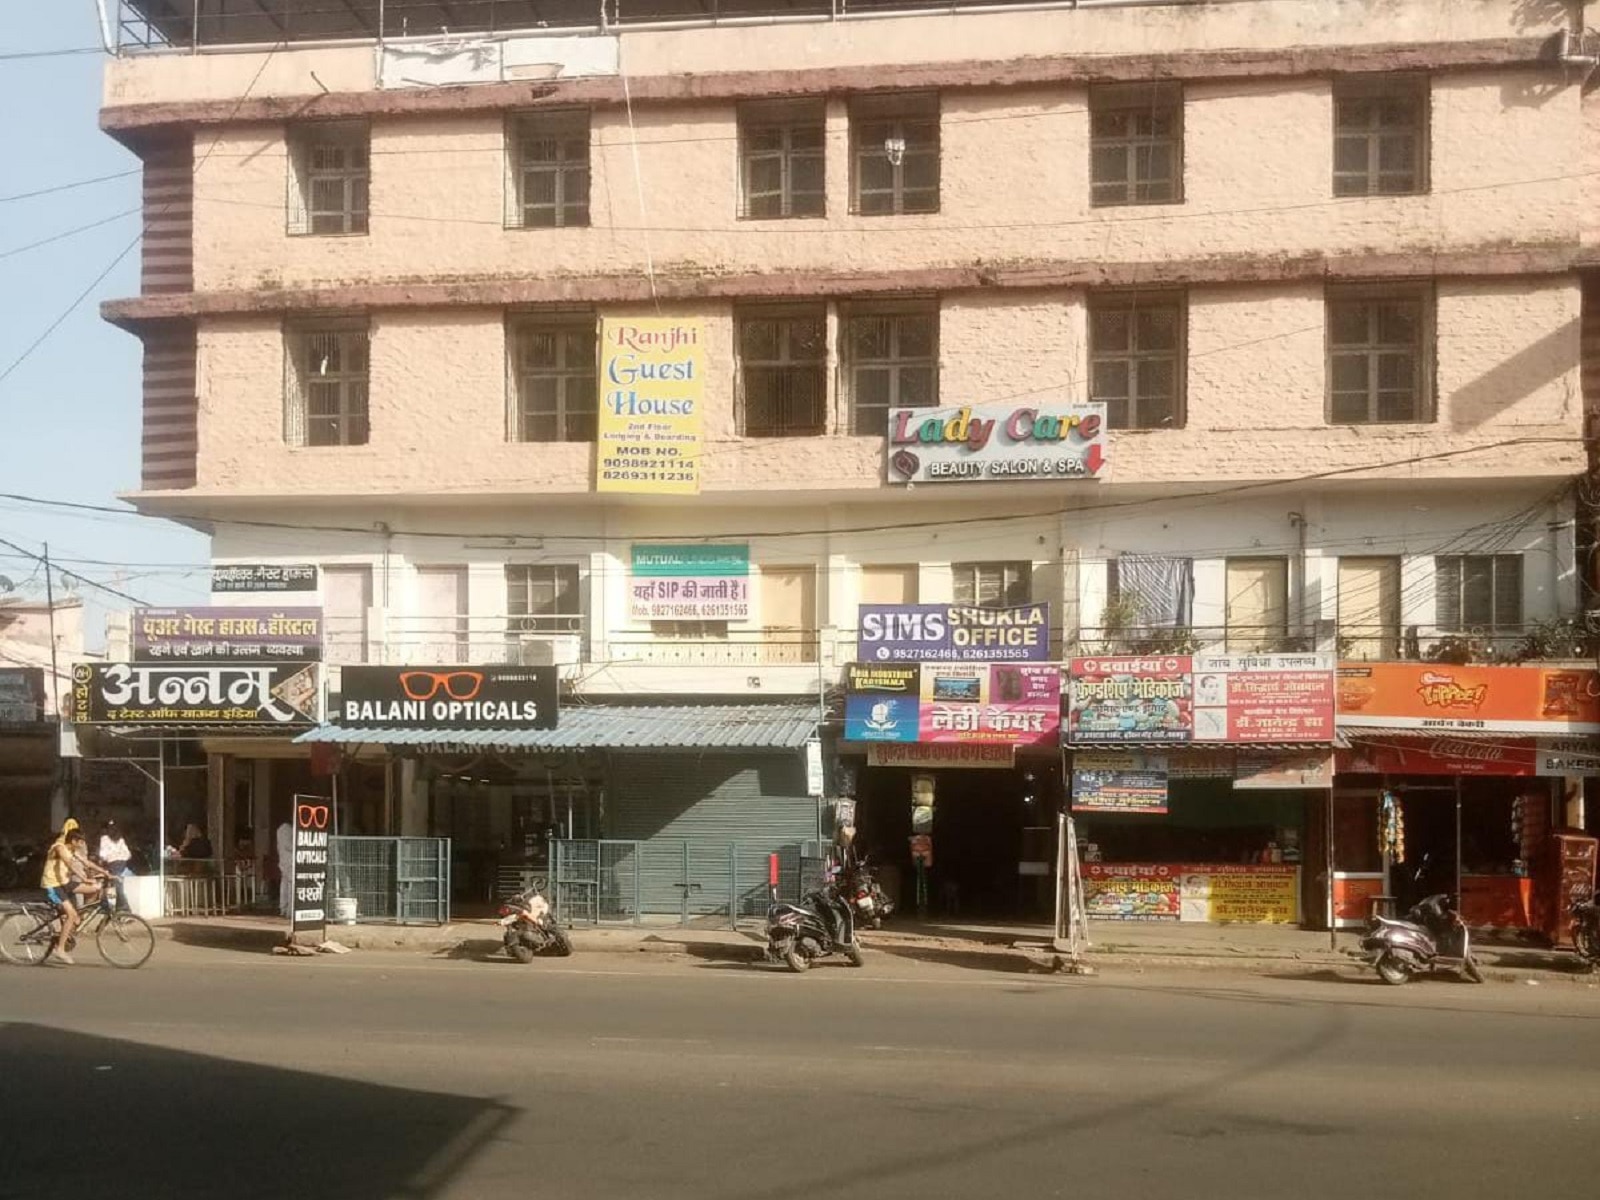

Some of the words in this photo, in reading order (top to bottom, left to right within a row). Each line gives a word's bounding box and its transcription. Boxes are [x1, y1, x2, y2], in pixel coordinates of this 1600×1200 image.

[607, 326, 697, 353] Ranjhi
[608, 354, 694, 385] Guest
[607, 391, 694, 415] House
[891, 406, 995, 451] Lady
[1005, 407, 1101, 442] Care
[616, 446, 652, 455] MOB
[656, 447, 682, 456] NO.
[931, 461, 985, 476] BEAUTY
[991, 460, 1037, 474] SALON
[1043, 459, 1052, 472] &
[1057, 458, 1085, 472] SPA
[658, 581, 679, 599] SIP
[682, 580, 697, 599] की
[700, 580, 727, 599] जाती
[184, 614, 216, 635] गेस्ट
[863, 613, 945, 641] SIMS
[947, 606, 1044, 626] SHUKLA
[953, 627, 1037, 646] OFFICE
[346, 701, 425, 720] BALANI
[432, 701, 537, 721] OPTICALS
[931, 705, 981, 731] लेडी
[986, 705, 1046, 733] केयर
[298, 831, 328, 847] BALANI
[297, 850, 327, 864] OPTICALS
